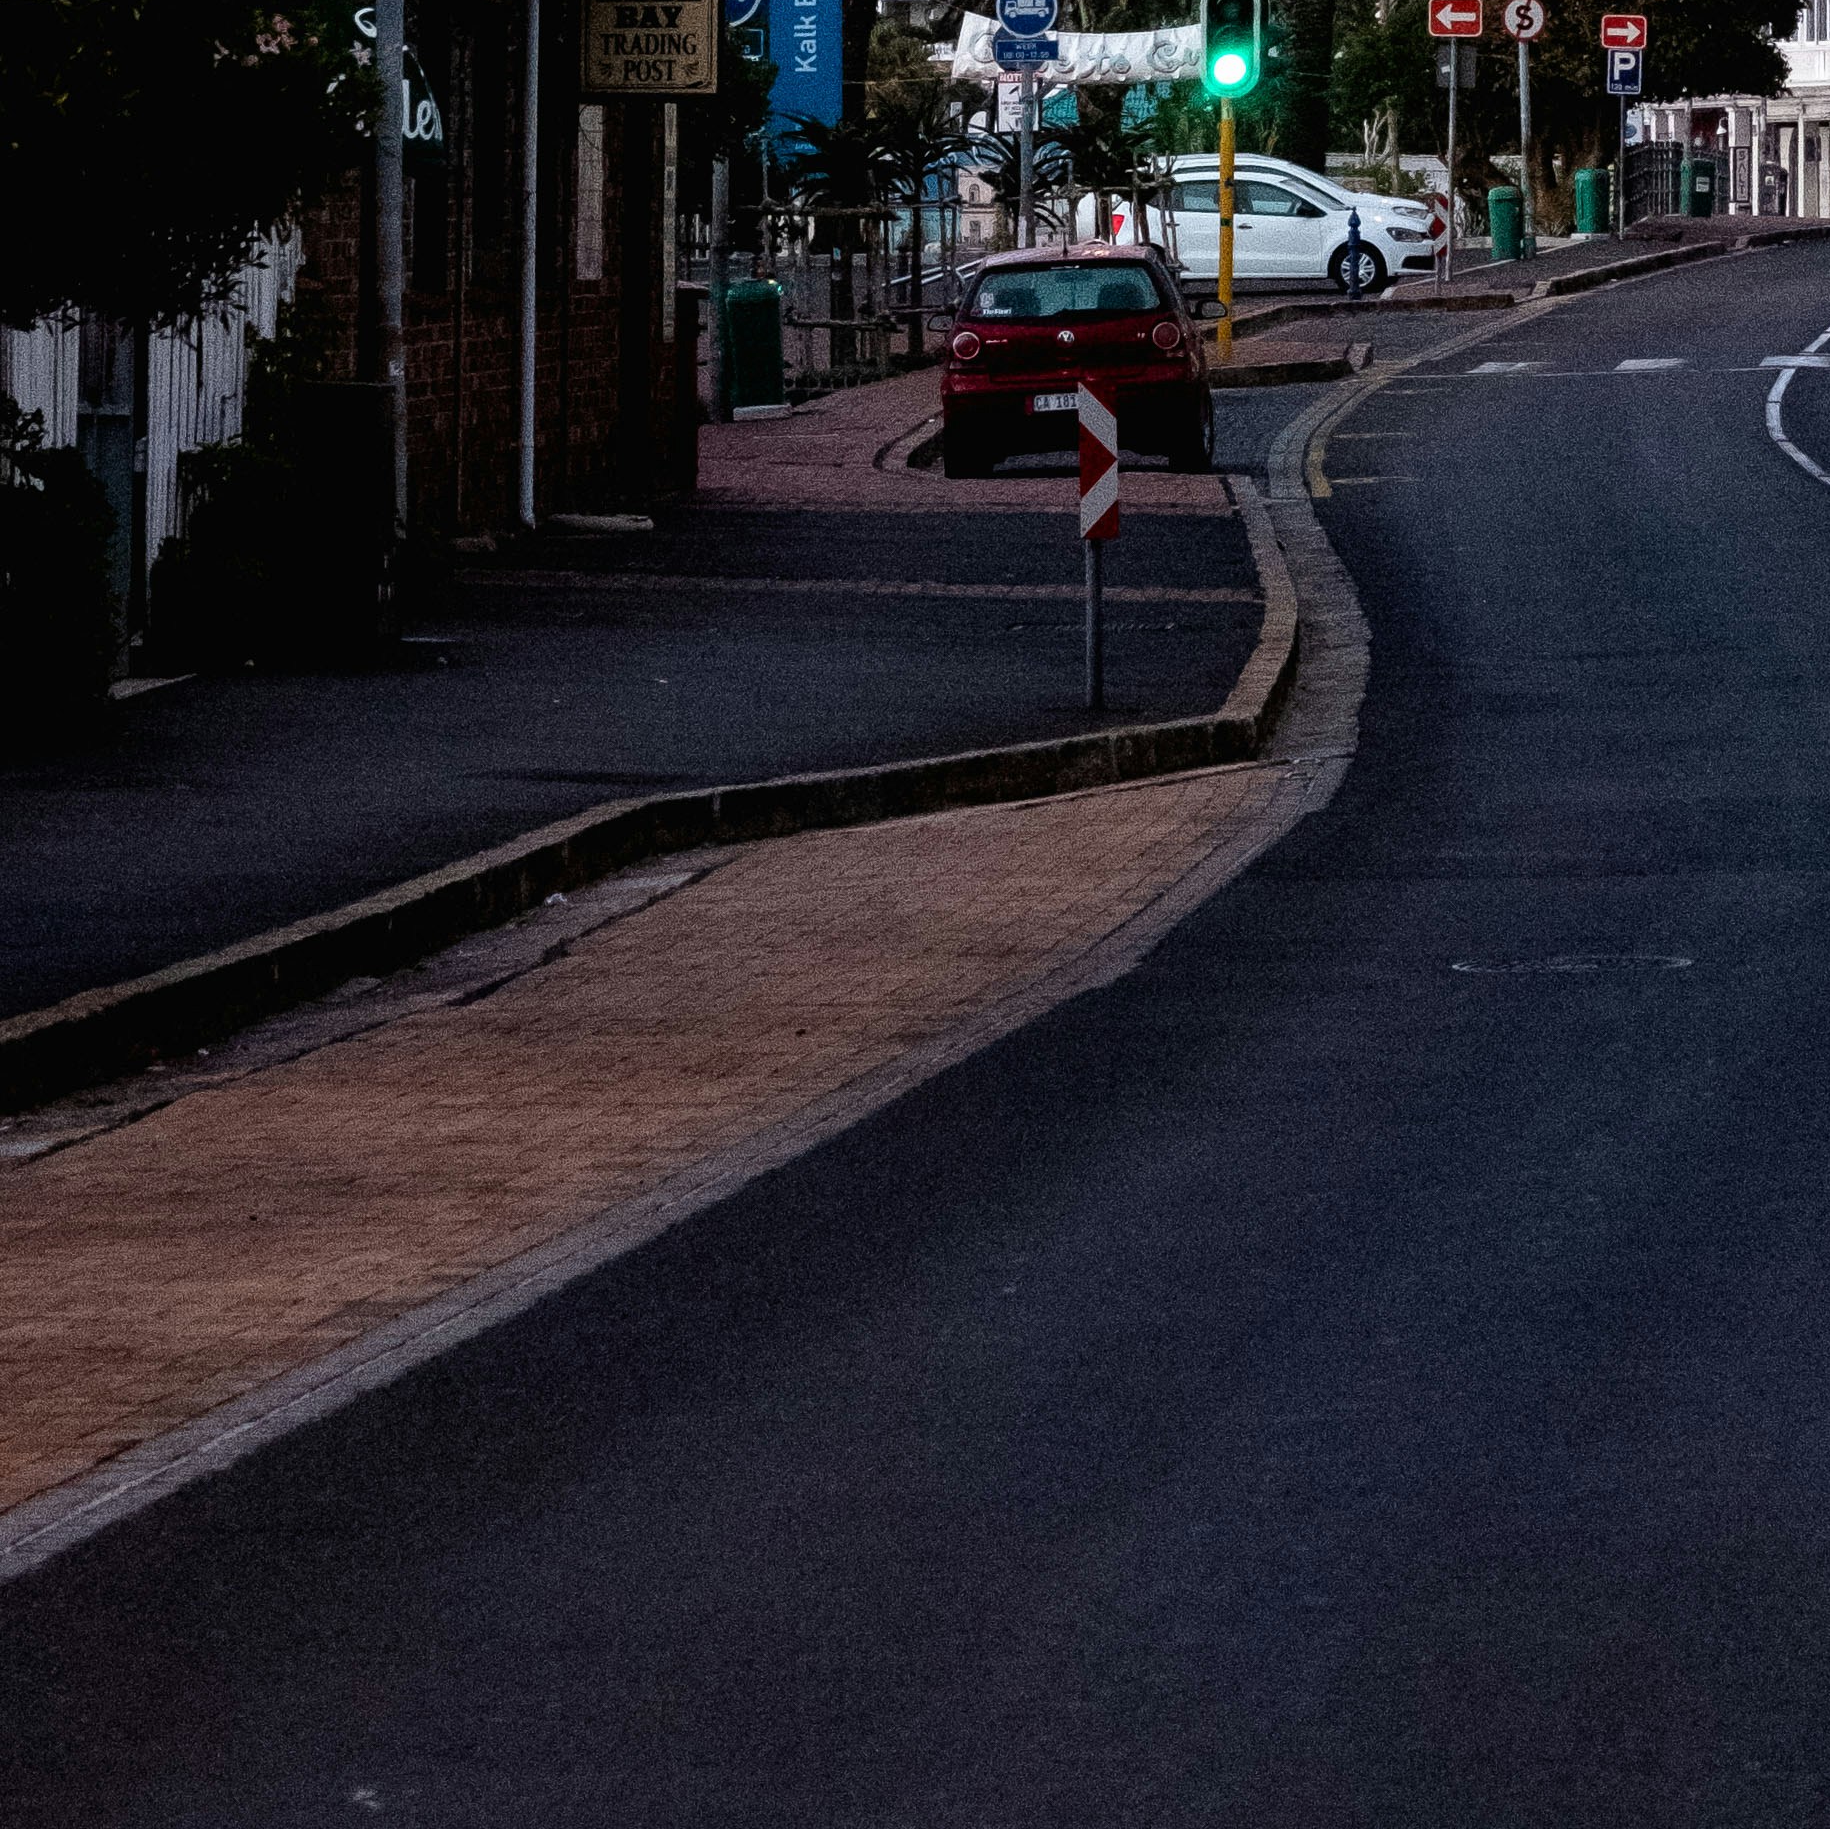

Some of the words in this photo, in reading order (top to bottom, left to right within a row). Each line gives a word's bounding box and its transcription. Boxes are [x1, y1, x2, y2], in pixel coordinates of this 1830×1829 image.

[614, 5, 683, 29] BAY
[600, 33, 698, 56] TRADING
[794, 12, 817, 73] Kalk
[623, 59, 676, 82] POST
[1614, 52, 1636, 81] P
[1035, 396, 1050, 410] CA
